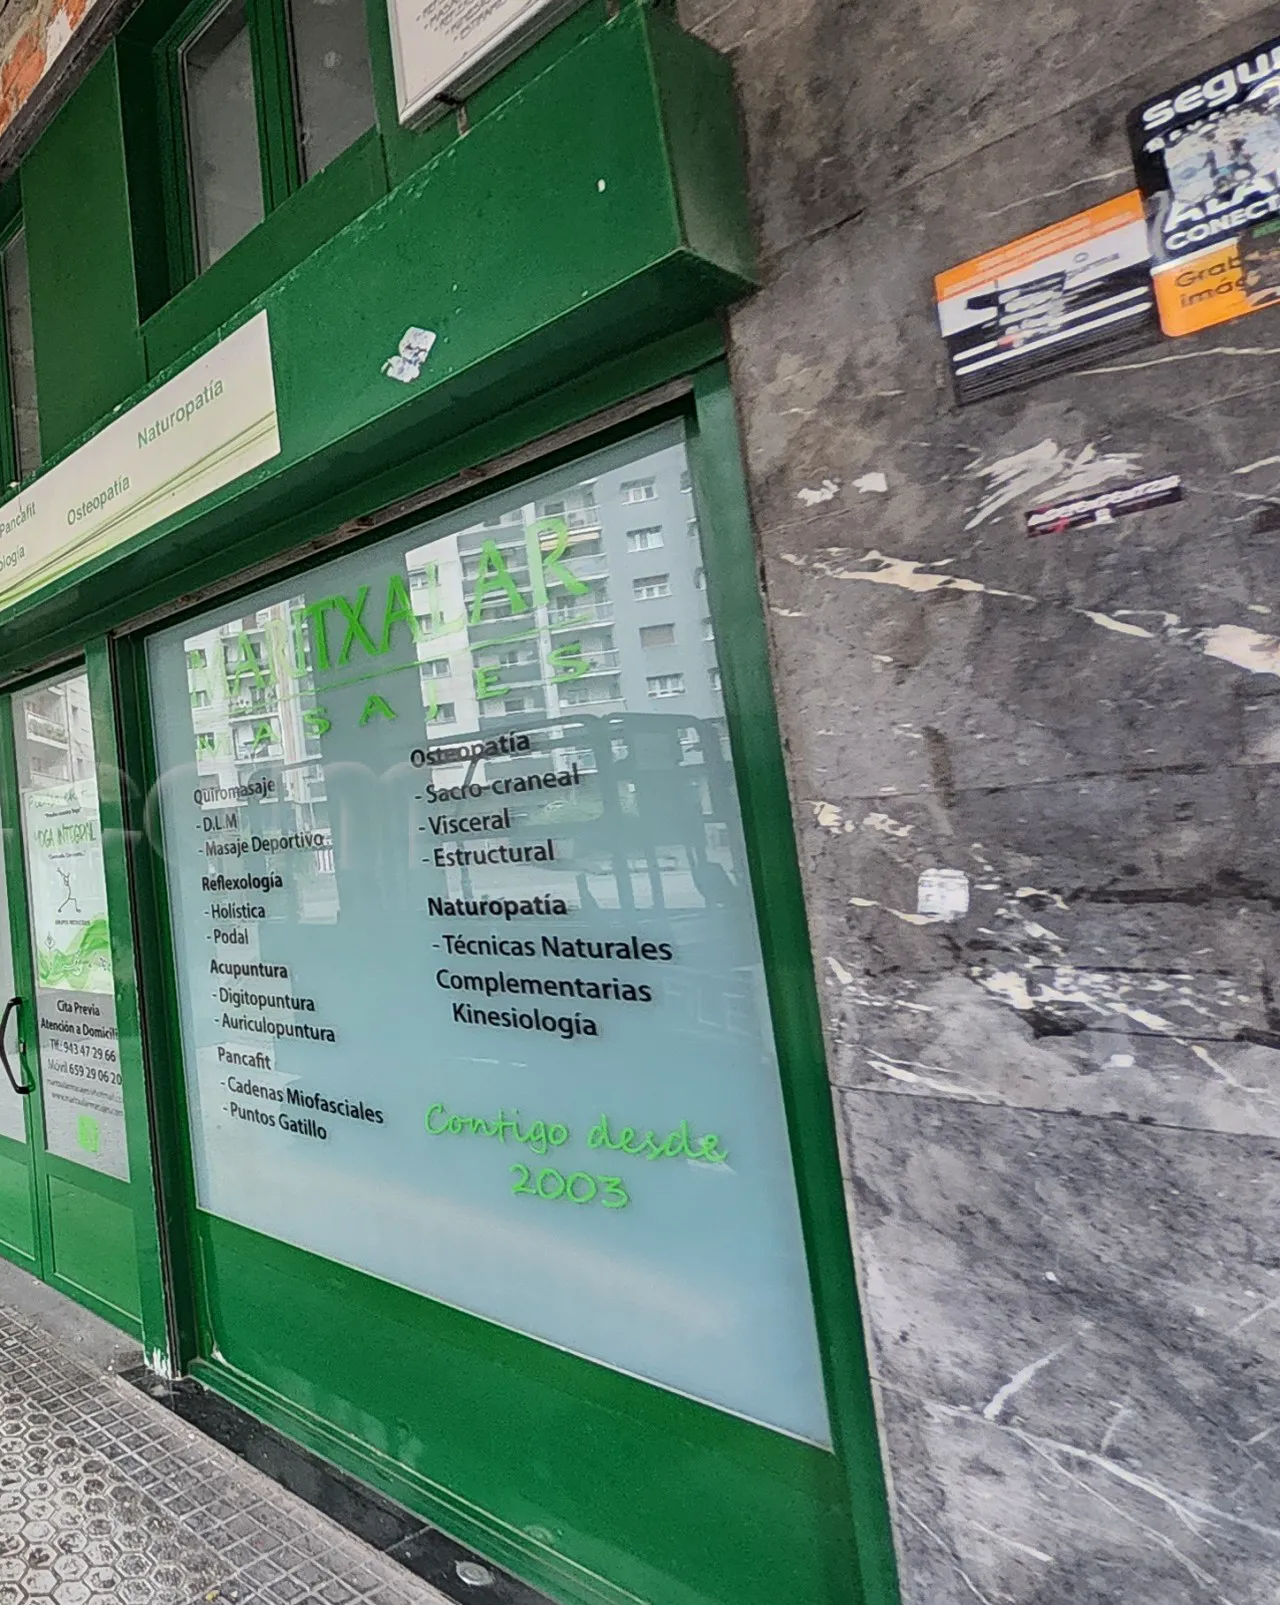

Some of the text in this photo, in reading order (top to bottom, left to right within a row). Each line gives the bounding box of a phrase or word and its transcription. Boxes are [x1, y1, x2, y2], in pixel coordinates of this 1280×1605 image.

[1163, 172, 1280, 233] ALA
[137, 379, 224, 449] Naturopatía
[67, 475, 131, 526] Osteopatía
[0, 502, 37, 538] Pancafit
[410, 731, 531, 768] Osteopatía
[193, 777, 276, 805] Quiromasaje
[425, 762, 581, 803] Sacro-craneal
[428, 807, 511, 836] Visceral
[205, 838, 249, 858] Masaje
[251, 832, 325, 855] Deportivo
[433, 839, 555, 867] Estructural
[202, 871, 284, 893] Reflexología
[211, 902, 266, 919] Holística
[427, 893, 568, 921] Naturopatía
[213, 928, 249, 945] Podal
[442, 934, 536, 957] Técnicas
[541, 935, 673, 961] Naturales
[210, 959, 288, 979] Acupuntura
[219, 987, 316, 1011] Digitopuntura
[436, 969, 653, 1002] Complementarias
[57, 1000, 100, 1016] Cita Previa
[452, 1003, 599, 1039] Kinesiología
[41, 1017, 75, 1034] Atención
[82, 1023, 119, 1040] Domicili
[222, 1012, 336, 1042] Auriculopuntura
[63, 1041, 79, 1055] 943
[80, 1044, 90, 1057] 47
[92, 1047, 103, 1060] 29
[104, 1049, 116, 1063] 66
[217, 1046, 272, 1071] Pancafit
[69, 1063, 85, 1077] 659
[85, 1066, 96, 1080] 29
[98, 1069, 109, 1083] 06
[110, 1072, 123, 1086] 20
[228, 1076, 284, 1102] Cadenas
[286, 1087, 385, 1125] Miofasciales
[230, 1102, 276, 1127] Puntos
[278, 1113, 328, 1140] Gatillo
[424, 1102, 729, 1163] Contigo desde
[509, 1163, 634, 1210] 2003
